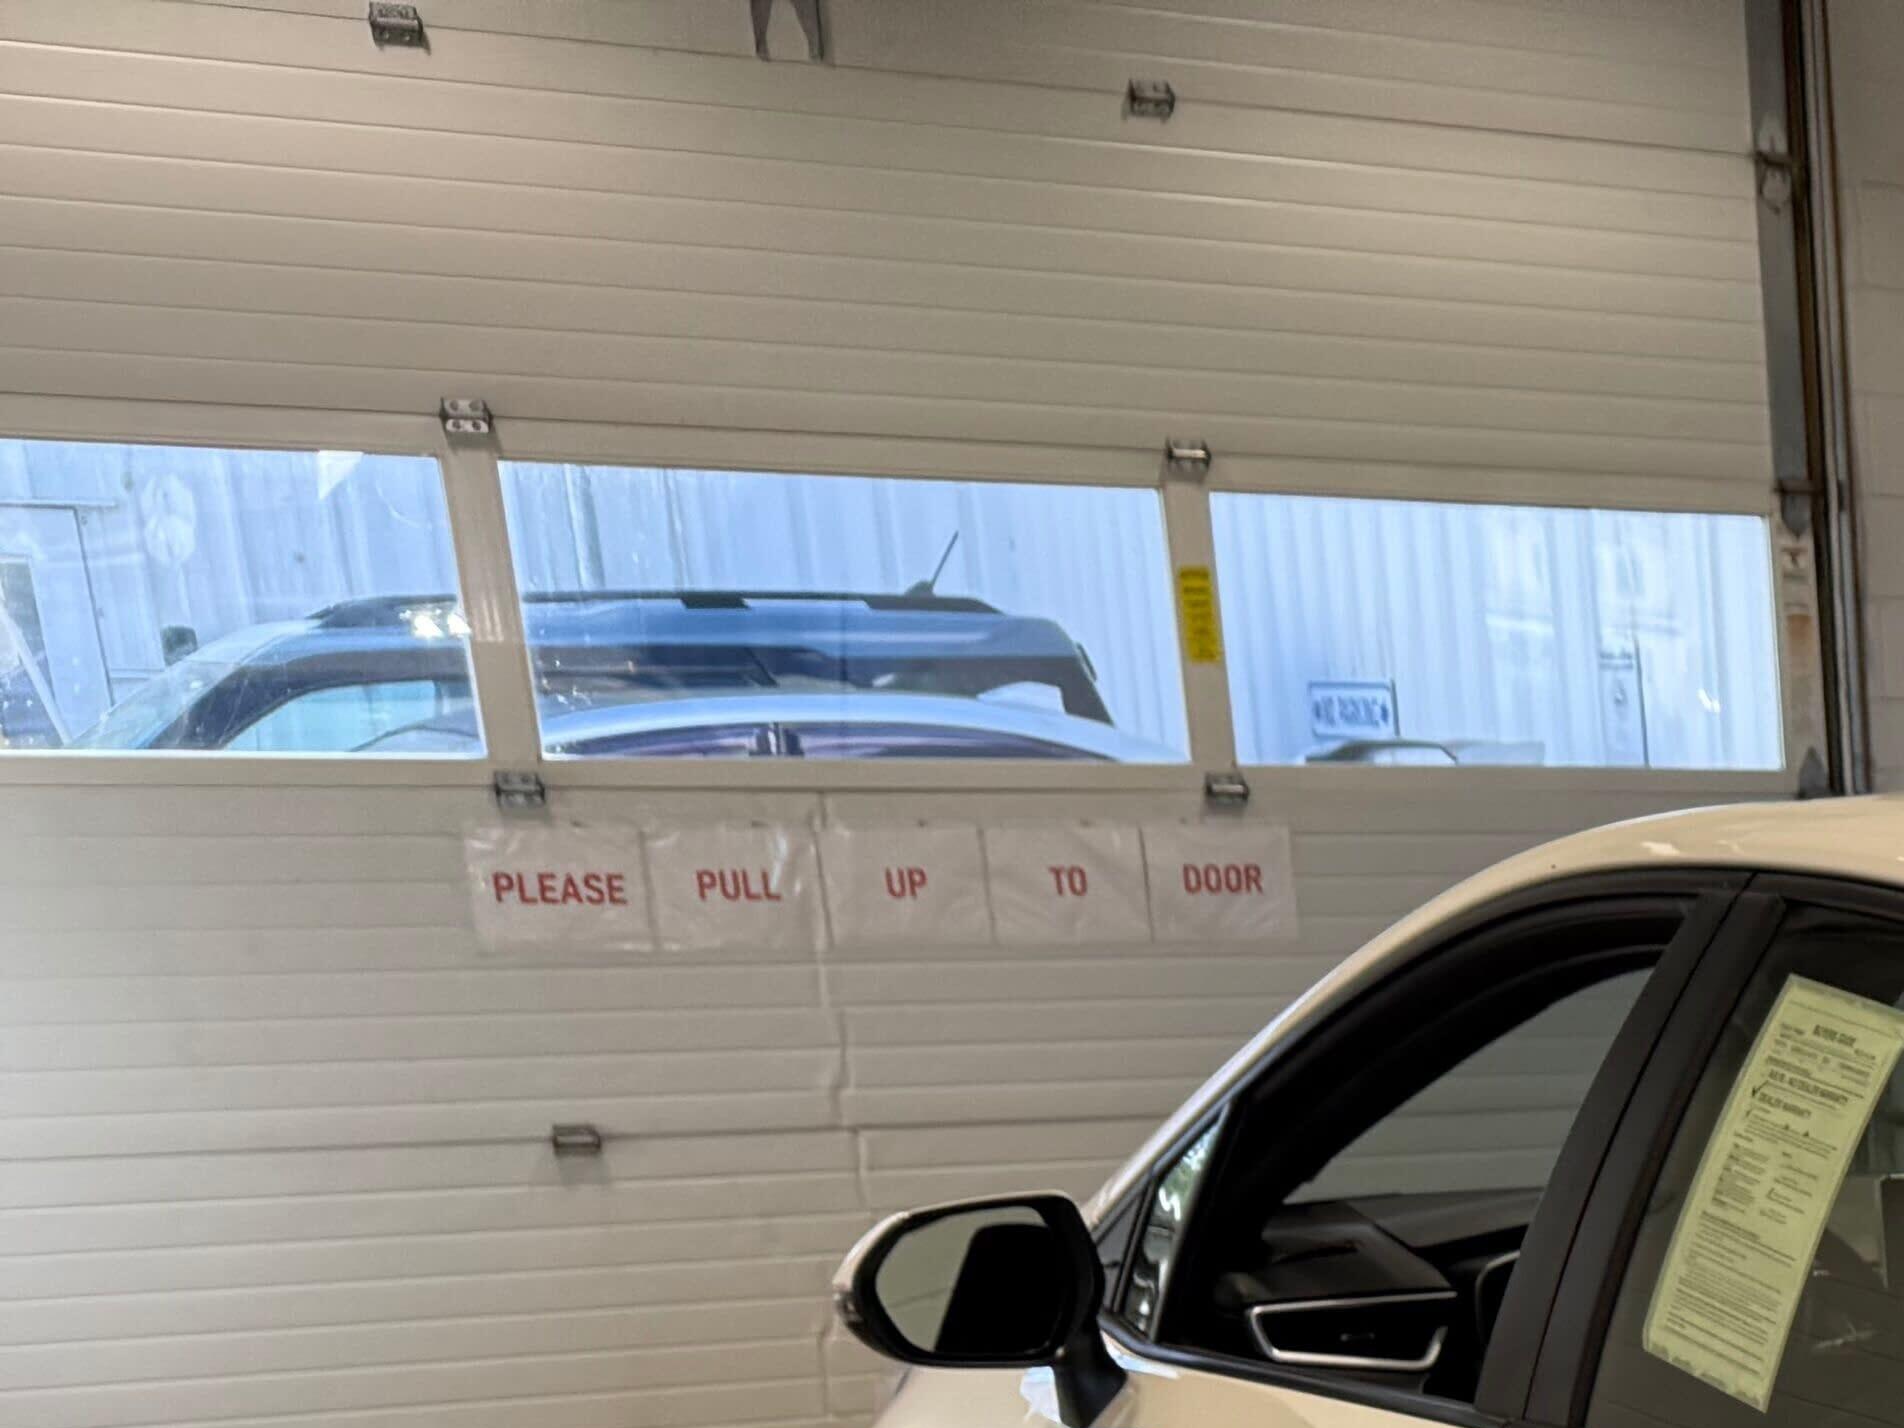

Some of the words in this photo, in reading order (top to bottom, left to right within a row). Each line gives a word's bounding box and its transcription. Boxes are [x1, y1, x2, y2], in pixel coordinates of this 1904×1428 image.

[492, 872, 628, 906] PLEASE
[696, 869, 782, 902] PULL
[886, 866, 928, 898] UP
[1051, 866, 1088, 897] TO
[1183, 864, 1262, 894] DOOR
